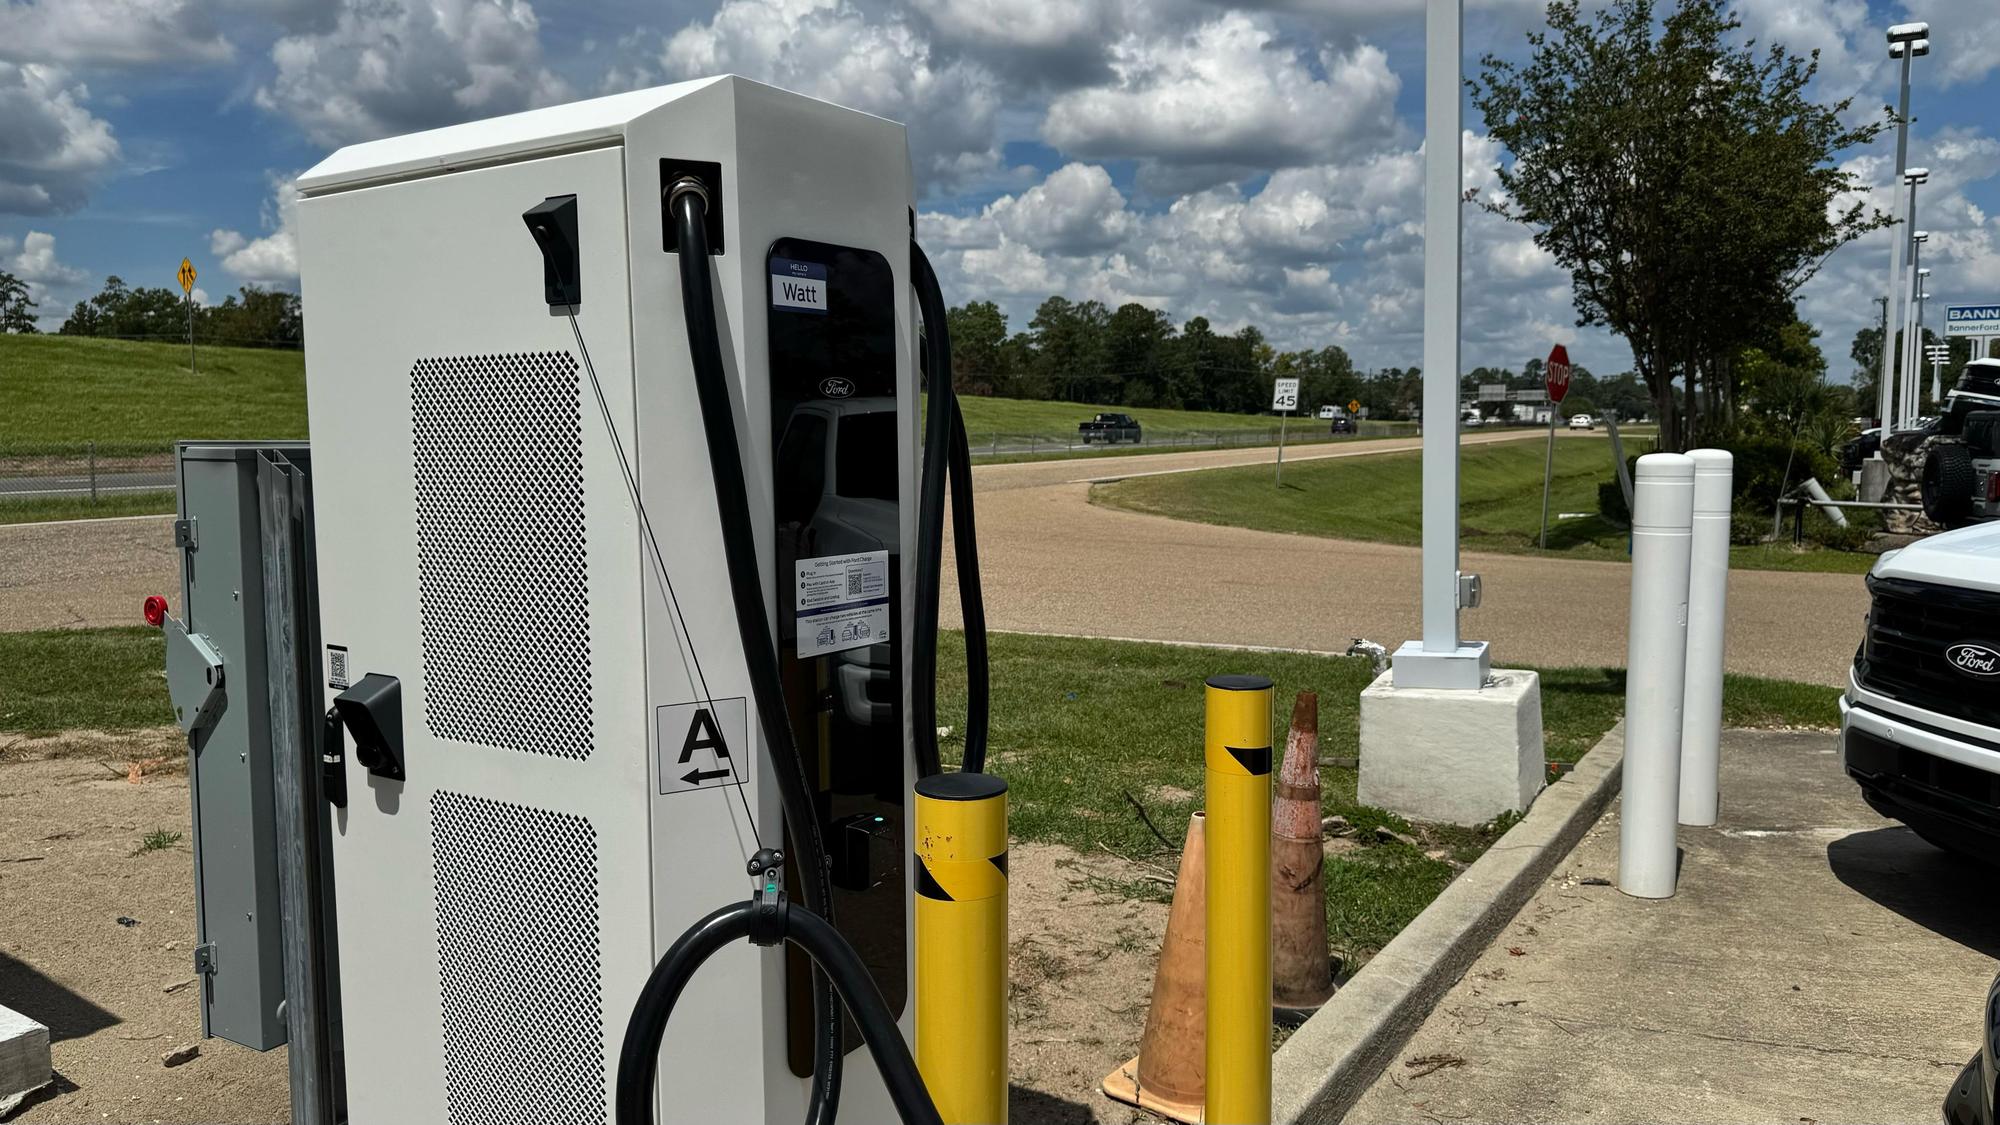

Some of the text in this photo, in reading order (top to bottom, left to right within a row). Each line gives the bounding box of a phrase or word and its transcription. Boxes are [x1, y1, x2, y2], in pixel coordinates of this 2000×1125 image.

[790, 263, 808, 272] HELLO
[783, 281, 817, 303] Watt
[1548, 361, 1569, 386] STOP
[825, 379, 849, 395] Ford
[1275, 395, 1296, 407] 45
[1957, 647, 1996, 671] Ford
[677, 708, 730, 764] A
